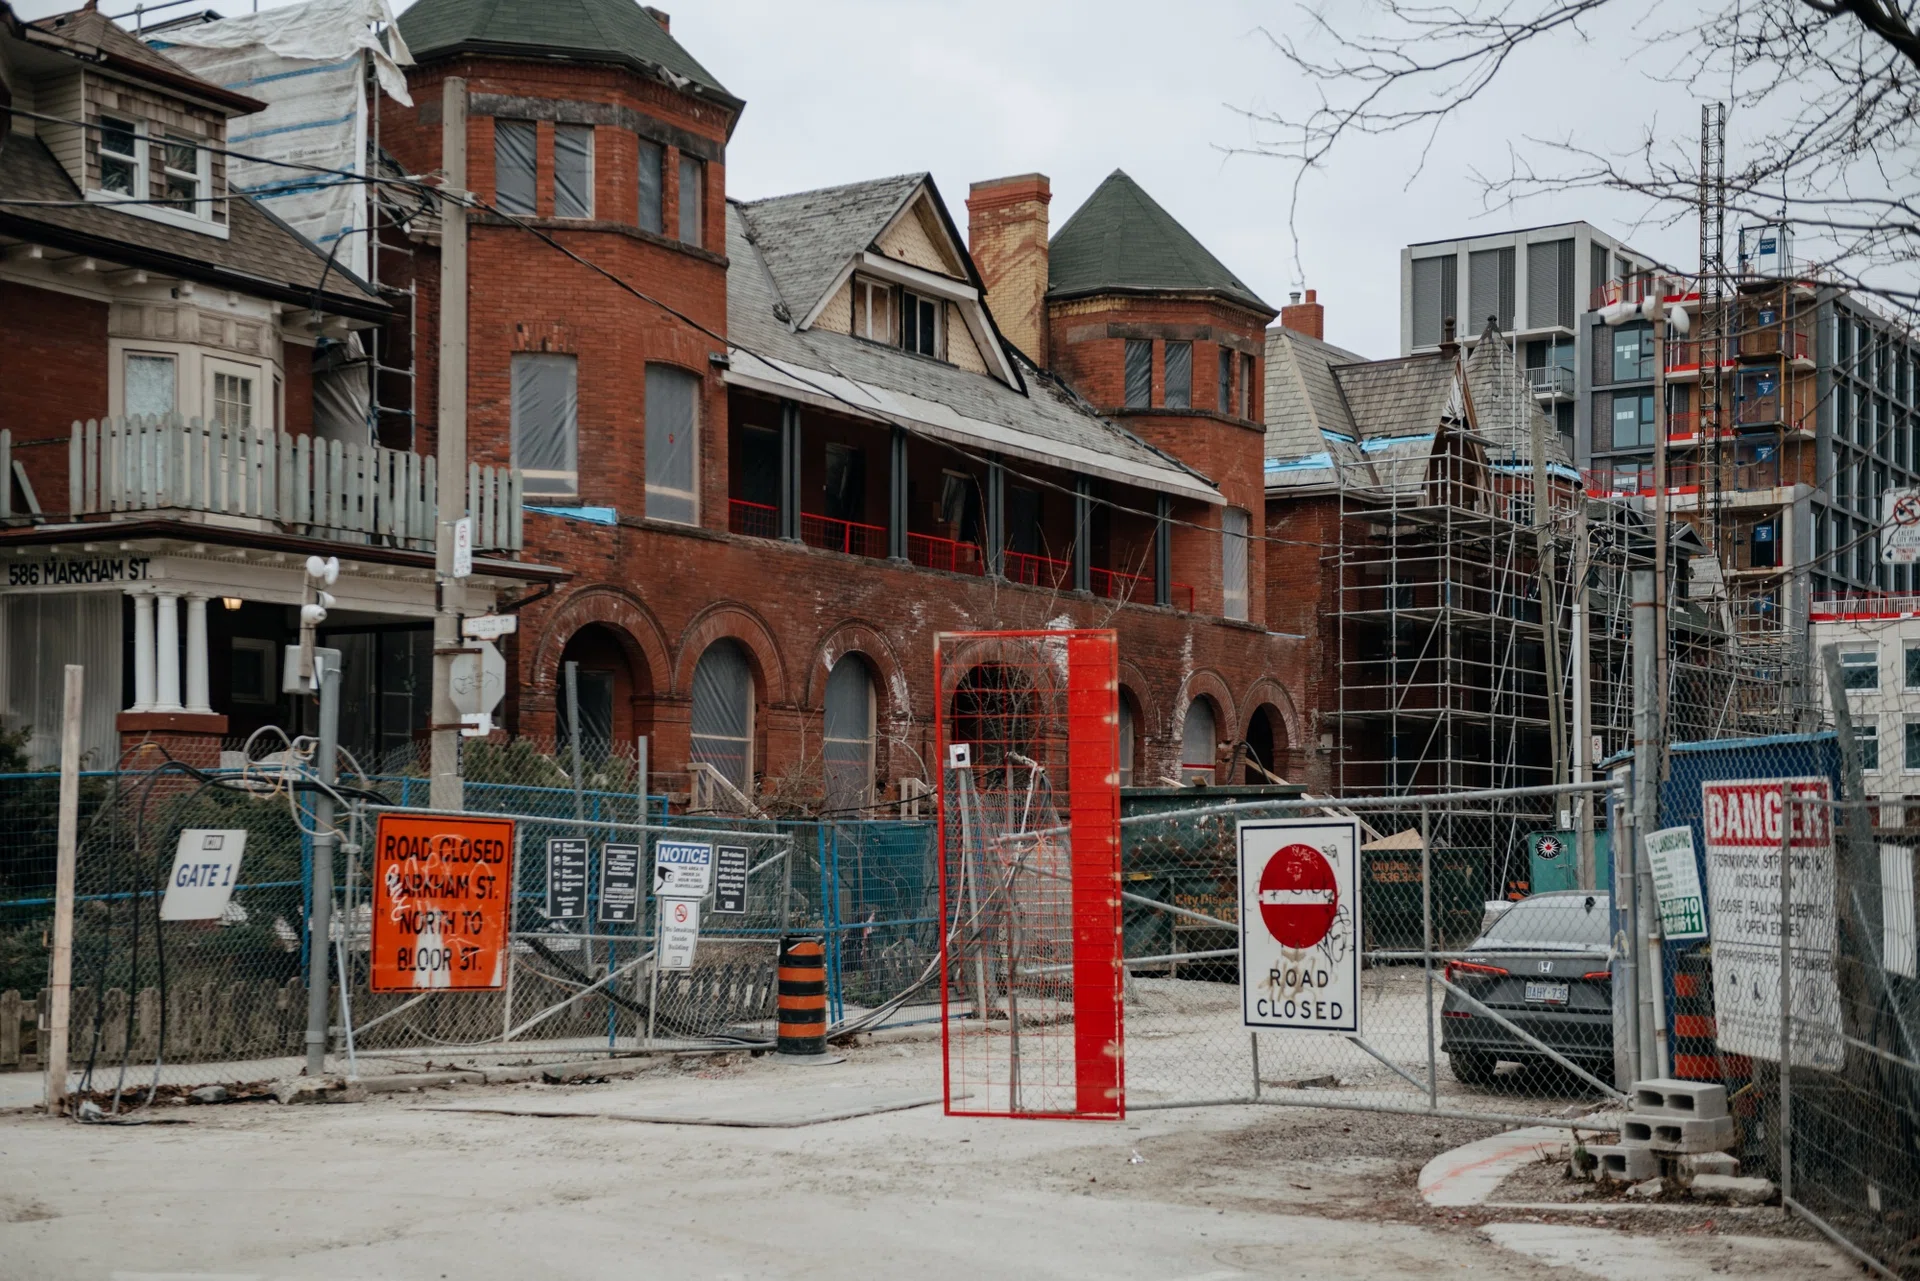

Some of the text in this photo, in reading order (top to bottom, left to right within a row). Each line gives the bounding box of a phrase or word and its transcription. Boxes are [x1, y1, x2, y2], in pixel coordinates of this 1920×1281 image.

[9, 558, 153, 585] 586 MARKHAM ST.
[1708, 790, 1823, 840] DANGER
[385, 835, 504, 864] ROAD CLOSED
[660, 847, 709, 864] NOTICE
[1763, 855, 1811, 871] STRPING
[176, 863, 232, 887] GATE 1
[386, 873, 469, 899] MARKHAM
[476, 875, 499, 899] ST.
[1736, 874, 1796, 889] INSTALLATN
[1175, 893, 1199, 907] City
[1717, 899, 1743, 914] LOOSE
[400, 910, 483, 935] NORTH TO
[1744, 919, 1767, 935] OPEN
[1771, 921, 1801, 937] EDES
[397, 946, 483, 972] BLOOR ST.
[1269, 968, 1329, 988] ROAD
[1257, 999, 1343, 1021] CLOSED
